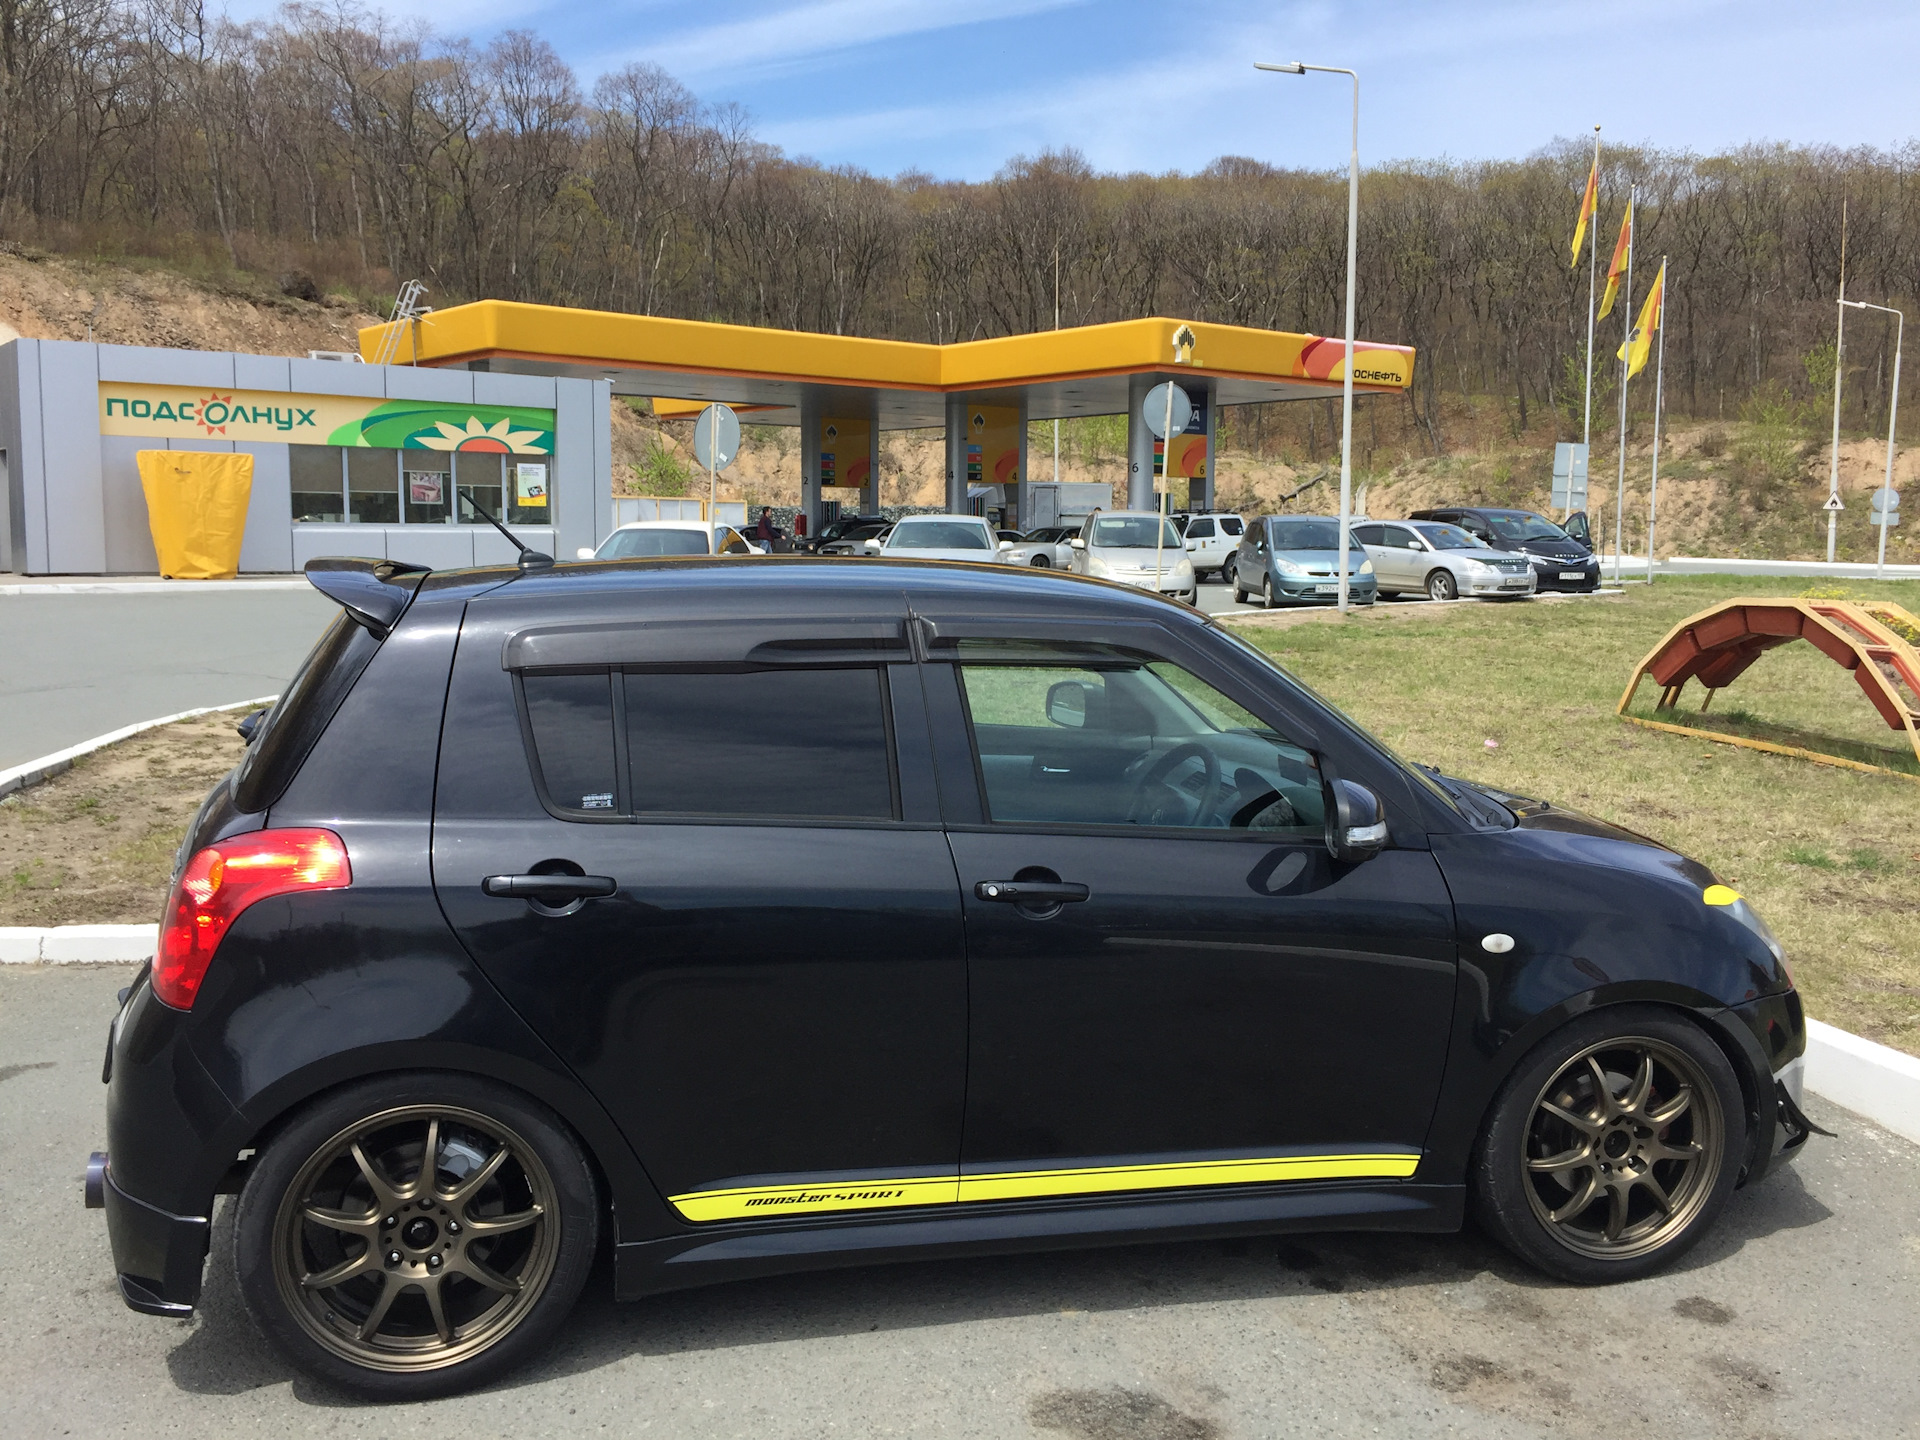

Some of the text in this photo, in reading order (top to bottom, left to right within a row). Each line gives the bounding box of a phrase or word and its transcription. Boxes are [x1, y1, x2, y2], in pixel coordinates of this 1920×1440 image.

[1352, 369, 1402, 383] ОСНЕФТЬ
[106, 398, 317, 431] ПОДСОЛНУХ
[1132, 462, 1139, 473] 6
[1200, 465, 1205, 475] 6
[803, 476, 809, 485] 2
[948, 471, 954, 480] 4
[1012, 472, 1017, 481] 4
[864, 478, 869, 487] 2
[745, 1190, 908, 1207] monster SPORT
